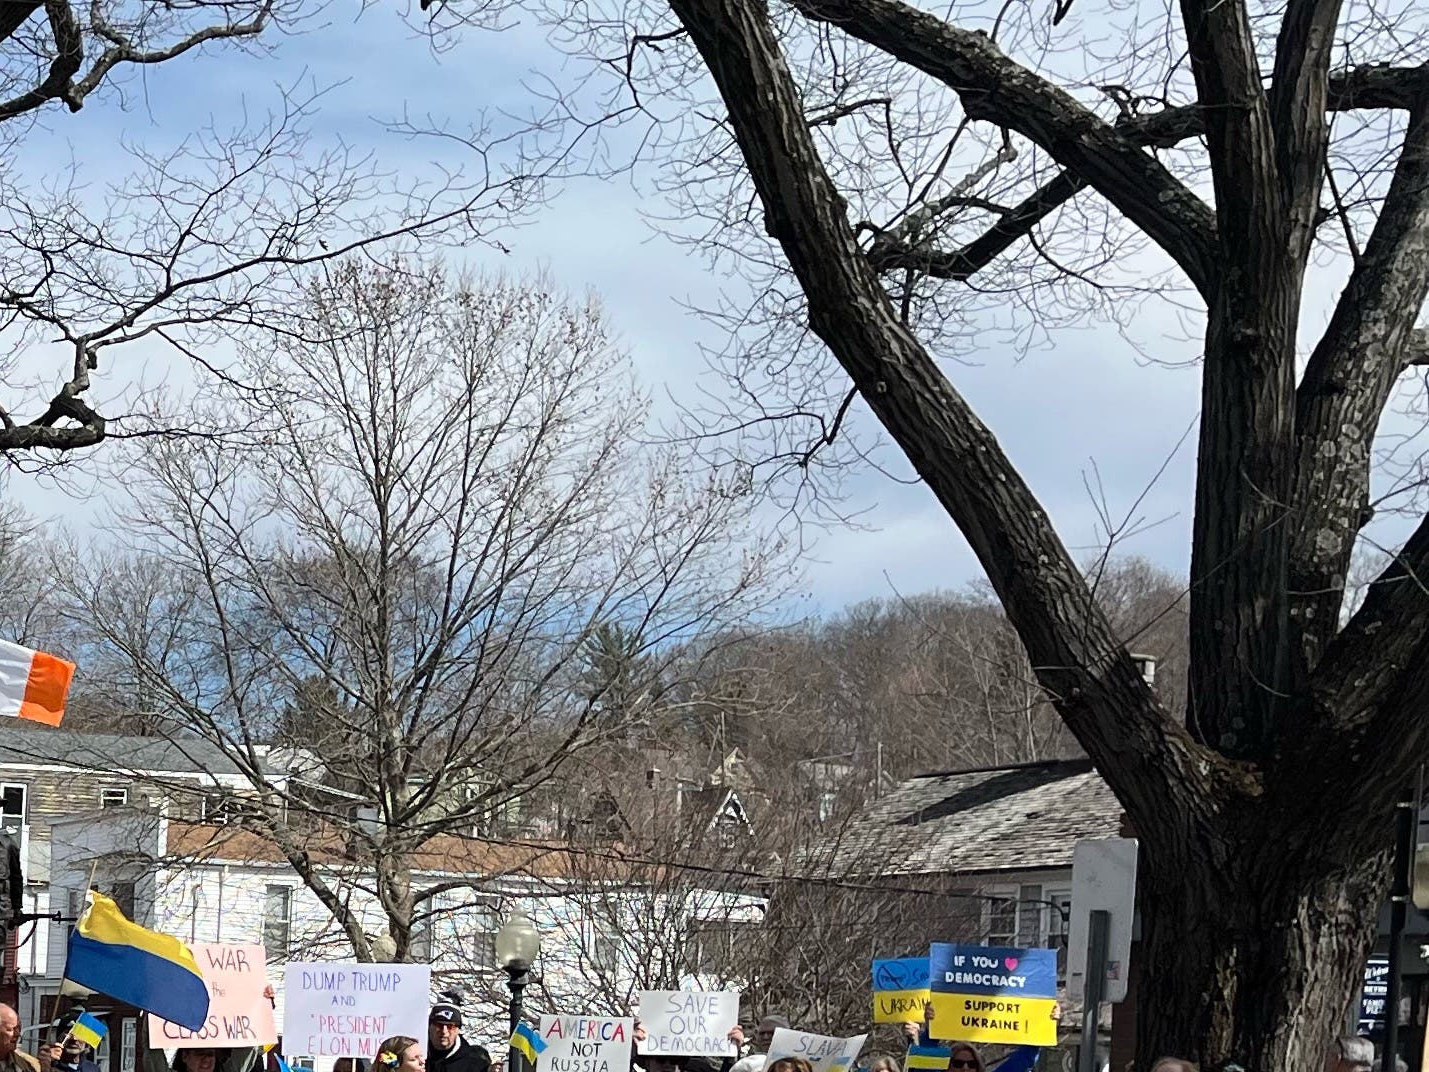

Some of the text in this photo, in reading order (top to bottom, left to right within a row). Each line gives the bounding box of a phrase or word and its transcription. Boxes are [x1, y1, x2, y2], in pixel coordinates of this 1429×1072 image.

[206, 947, 251, 973] WAR
[954, 955, 999, 969] IF YOU
[211, 981, 226, 998] the
[302, 971, 401, 992] DUMP TRUMP
[945, 971, 1026, 988] DEMOCRACY
[331, 995, 356, 1007] AND
[665, 994, 720, 1015] SAVE
[964, 1000, 1020, 1014] SUPPORT
[223, 1015, 258, 1040] WAR
[546, 1018, 626, 1043] AMERICA
[669, 1015, 707, 1036] OUR
[308, 1035, 351, 1056] ELON
[571, 1042, 602, 1058] NOT
[647, 1034, 735, 1053] DEMOCRACY
[793, 1036, 848, 1057] SLAVA
